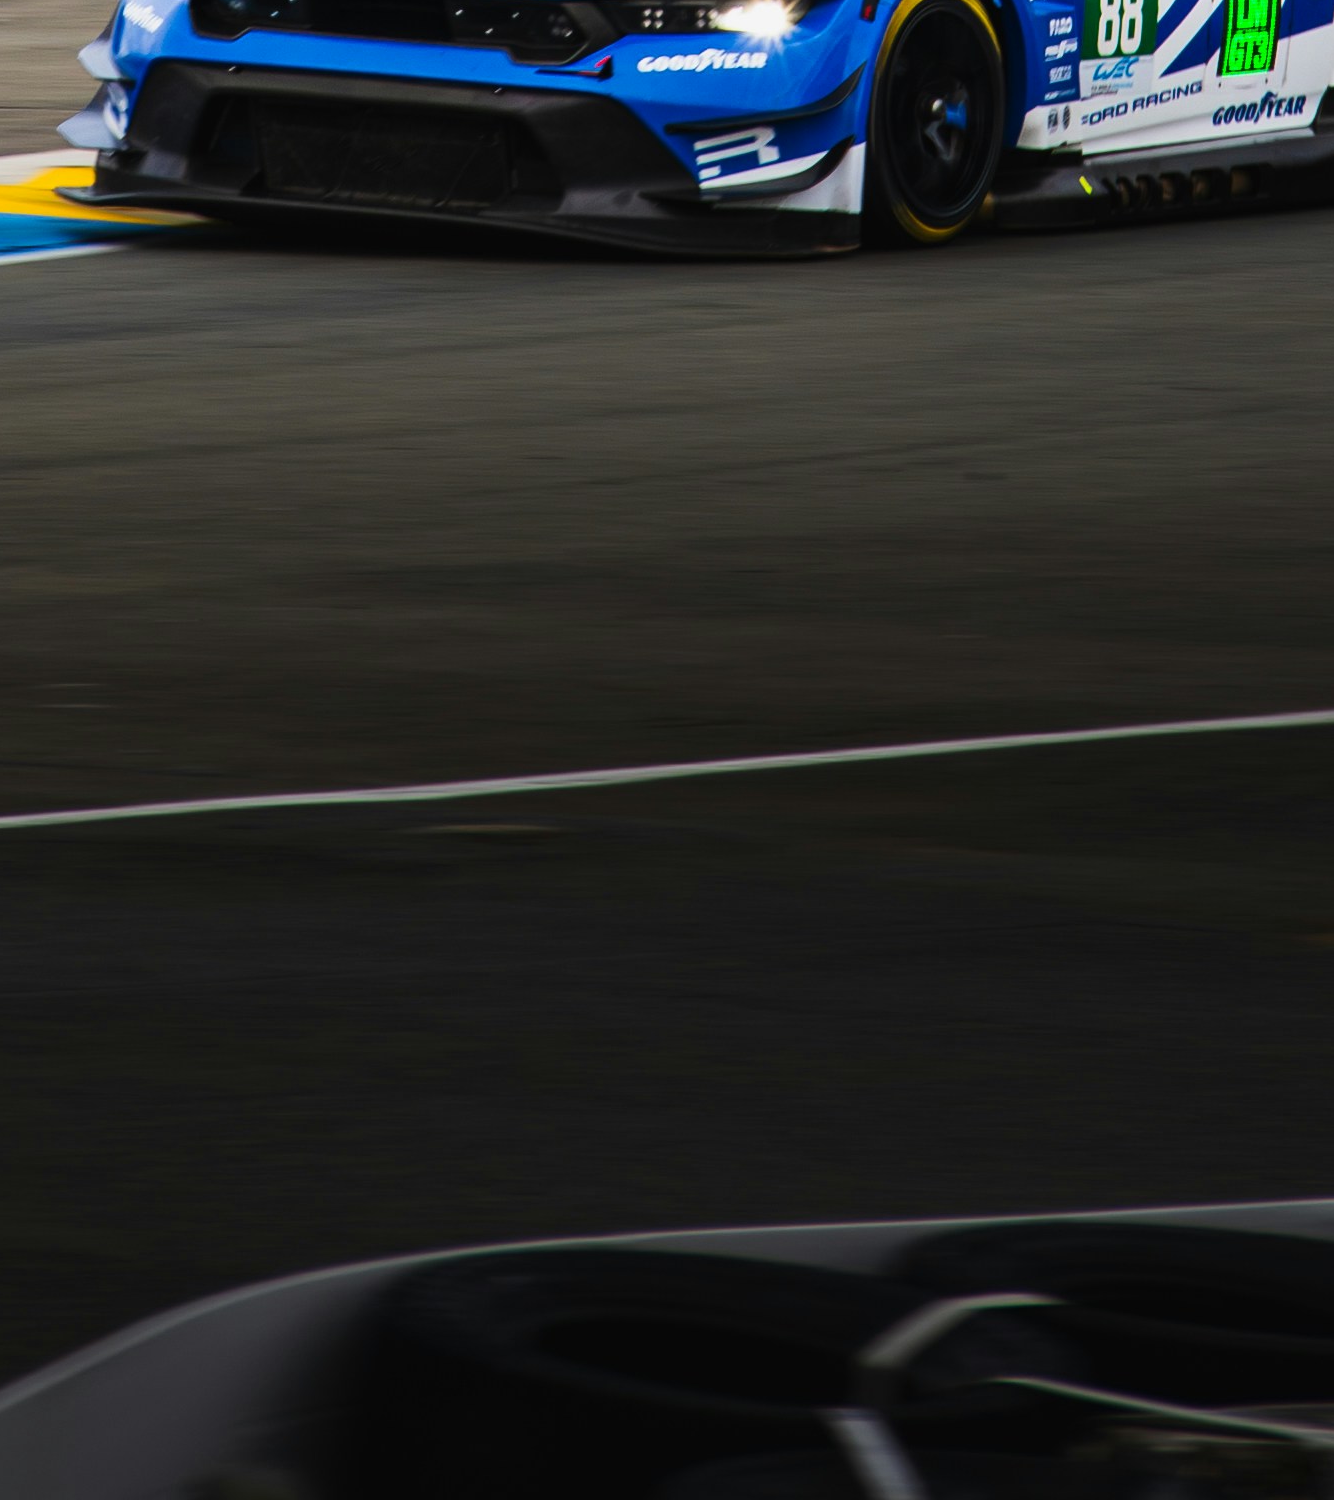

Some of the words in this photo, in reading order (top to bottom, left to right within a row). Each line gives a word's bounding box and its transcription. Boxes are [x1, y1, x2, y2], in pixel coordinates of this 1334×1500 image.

[637, 48, 768, 73] GOODYEAR
[1229, 31, 1269, 71] GT3
[1092, 56, 1139, 82] WEC
[1132, 79, 1204, 112] RACING
[1212, 91, 1307, 127] GOODYEAR
